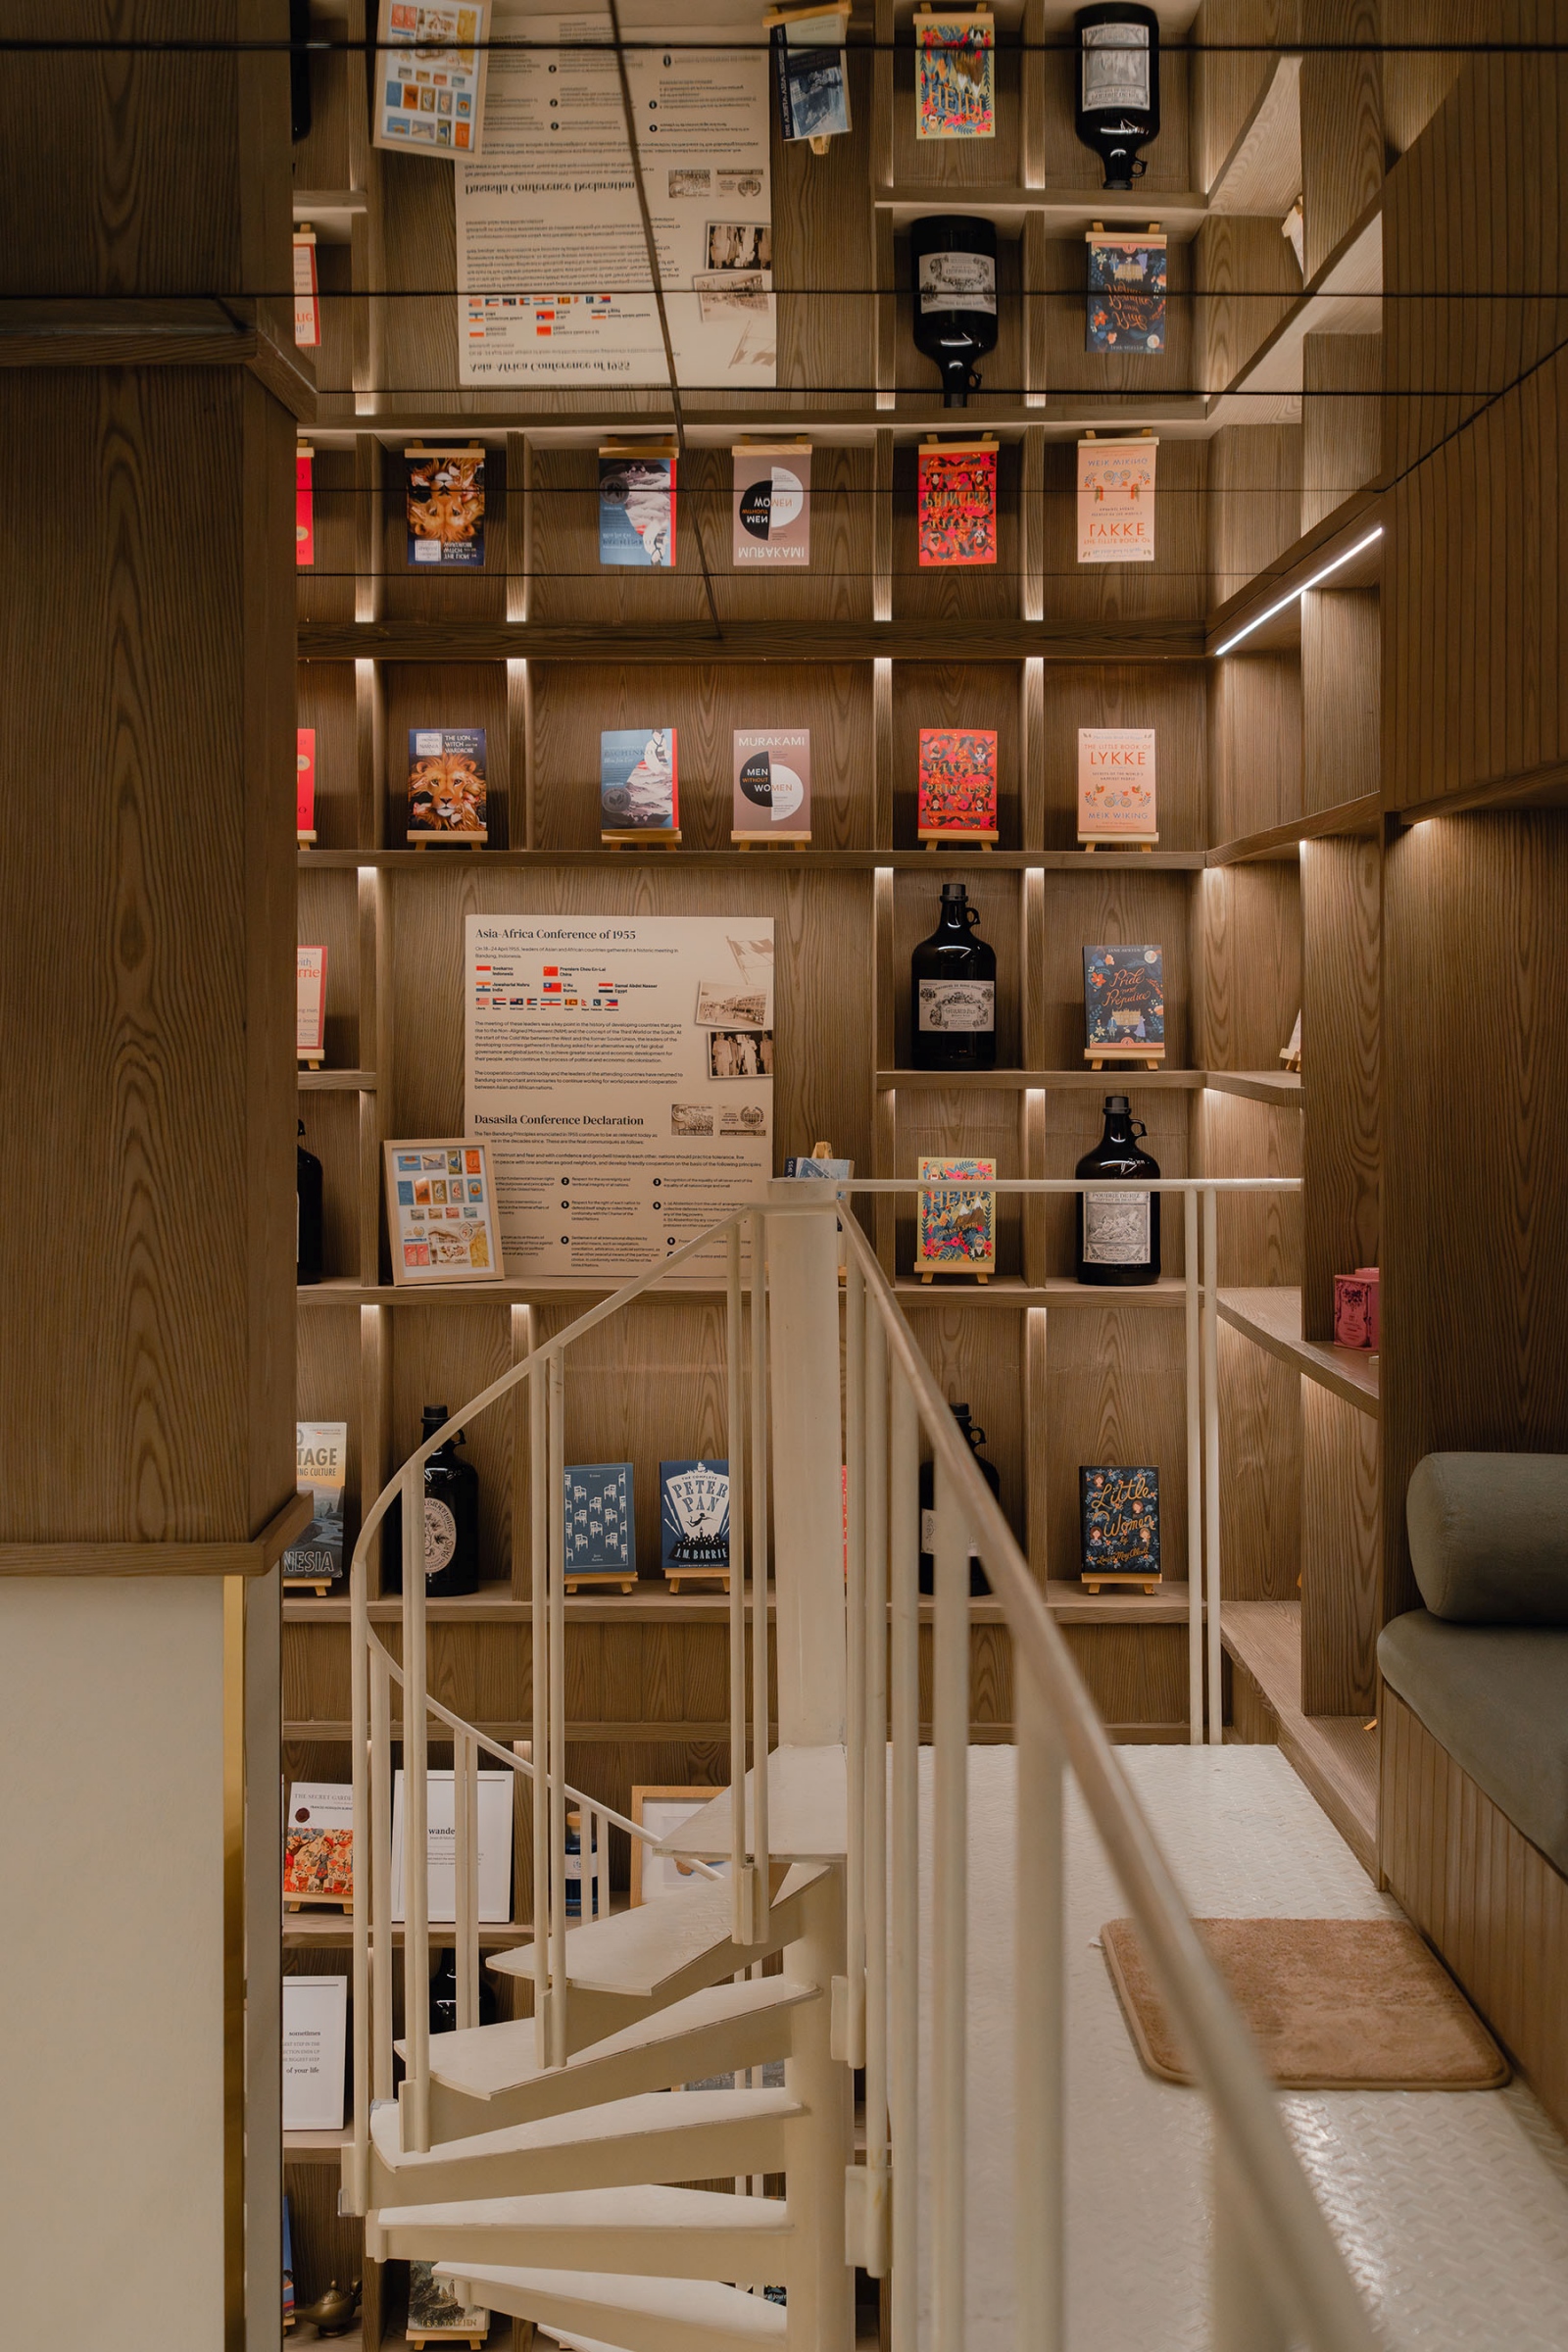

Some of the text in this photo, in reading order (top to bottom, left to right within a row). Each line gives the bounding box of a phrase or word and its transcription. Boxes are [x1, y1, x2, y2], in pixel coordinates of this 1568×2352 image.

[738, 737, 805, 746] MURAKAMI
[1090, 752, 1146, 765] LYKKE
[754, 784, 793, 792] WOMEN
[476, 929, 636, 939] Asia-Africa Conference of 1955
[1109, 968, 1145, 988] Pride
[1102, 989, 1151, 1009] Prejudice
[475, 1114, 644, 1125] Dasasila Conference Declaration
[931, 1191, 984, 1210] HEI
[310, 1468, 336, 1476] CULTURE
[672, 1480, 728, 1498] PETER
[1091, 1478, 1149, 1510] Little
[682, 1496, 719, 1512] PAN
[1093, 1511, 1156, 1537] Women
[441, 1540, 454, 1559] PARIS
[676, 1548, 728, 1560] J.M. BARRIE
